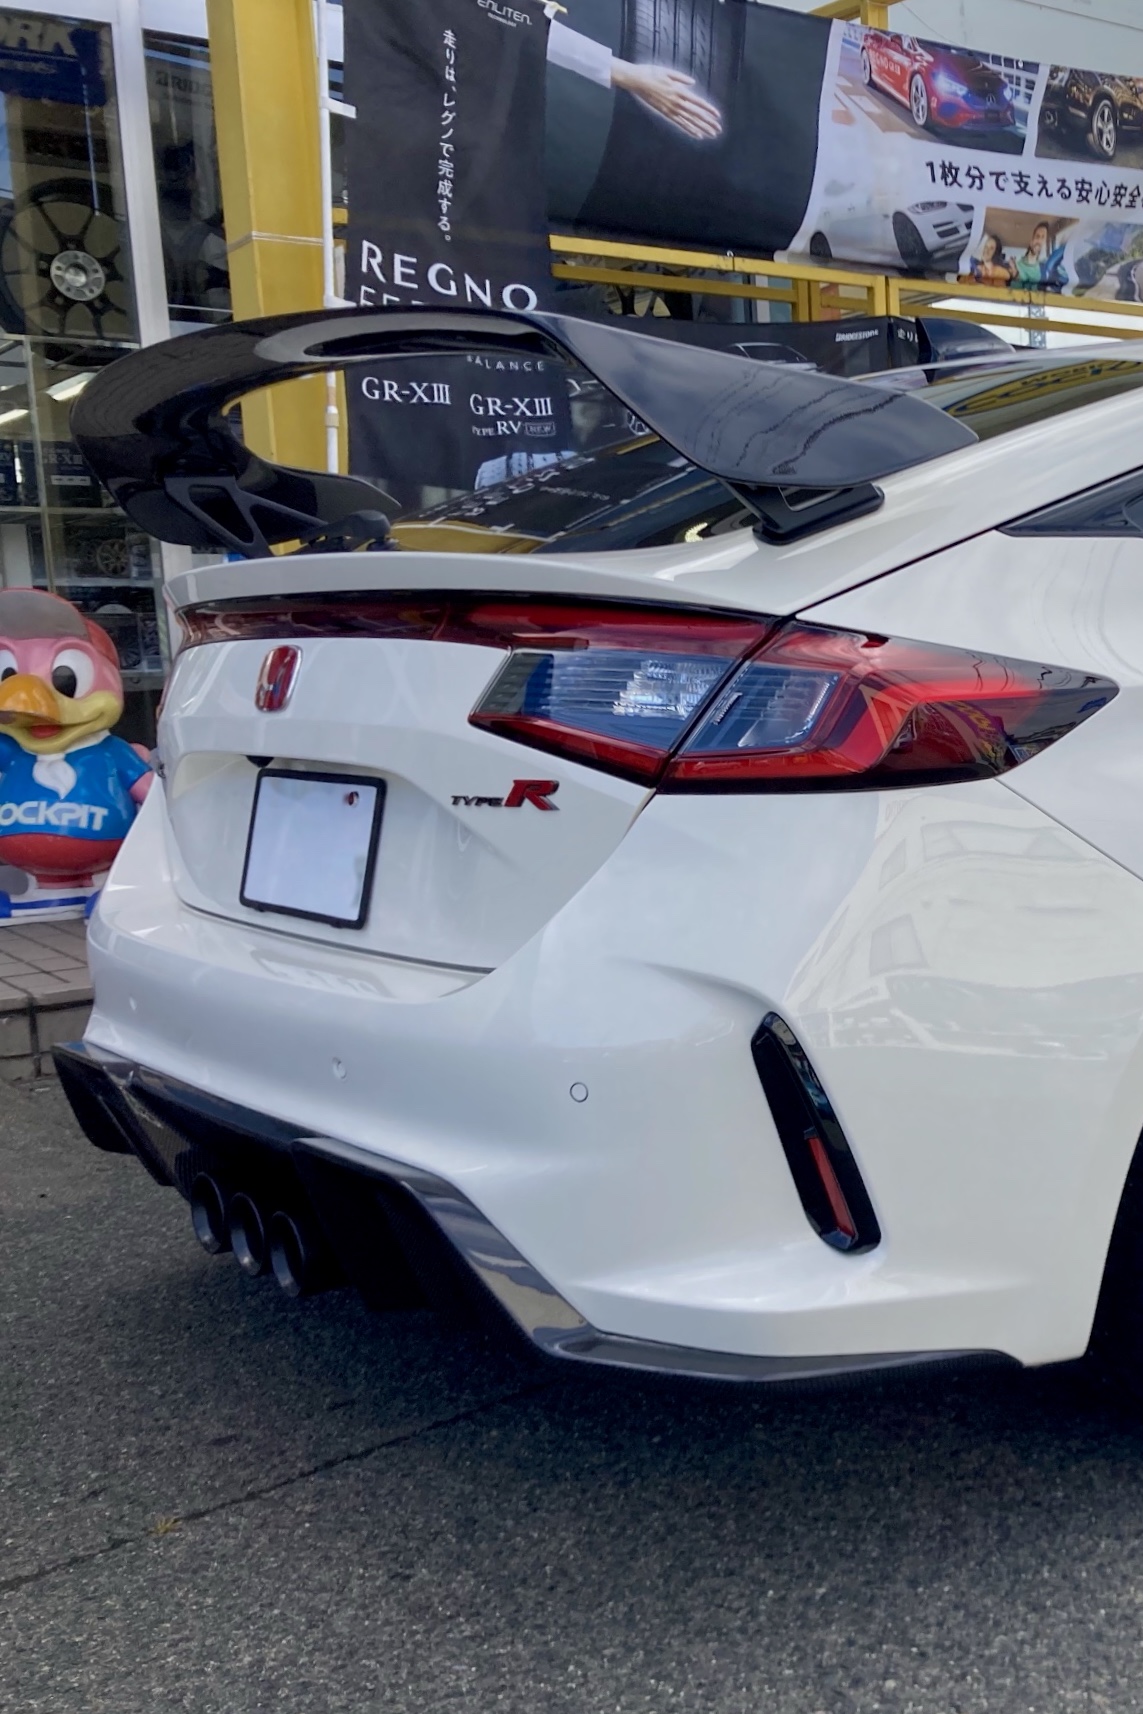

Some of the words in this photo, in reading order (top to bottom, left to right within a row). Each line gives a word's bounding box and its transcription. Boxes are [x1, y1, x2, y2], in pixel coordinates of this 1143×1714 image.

[437, 29, 457, 242] 走りは、レグノで完成する。
[361, 239, 538, 311] REGNO
[496, 420, 522, 436] RV
[451, 795, 504, 808] TYPE
[503, 779, 561, 812] R
